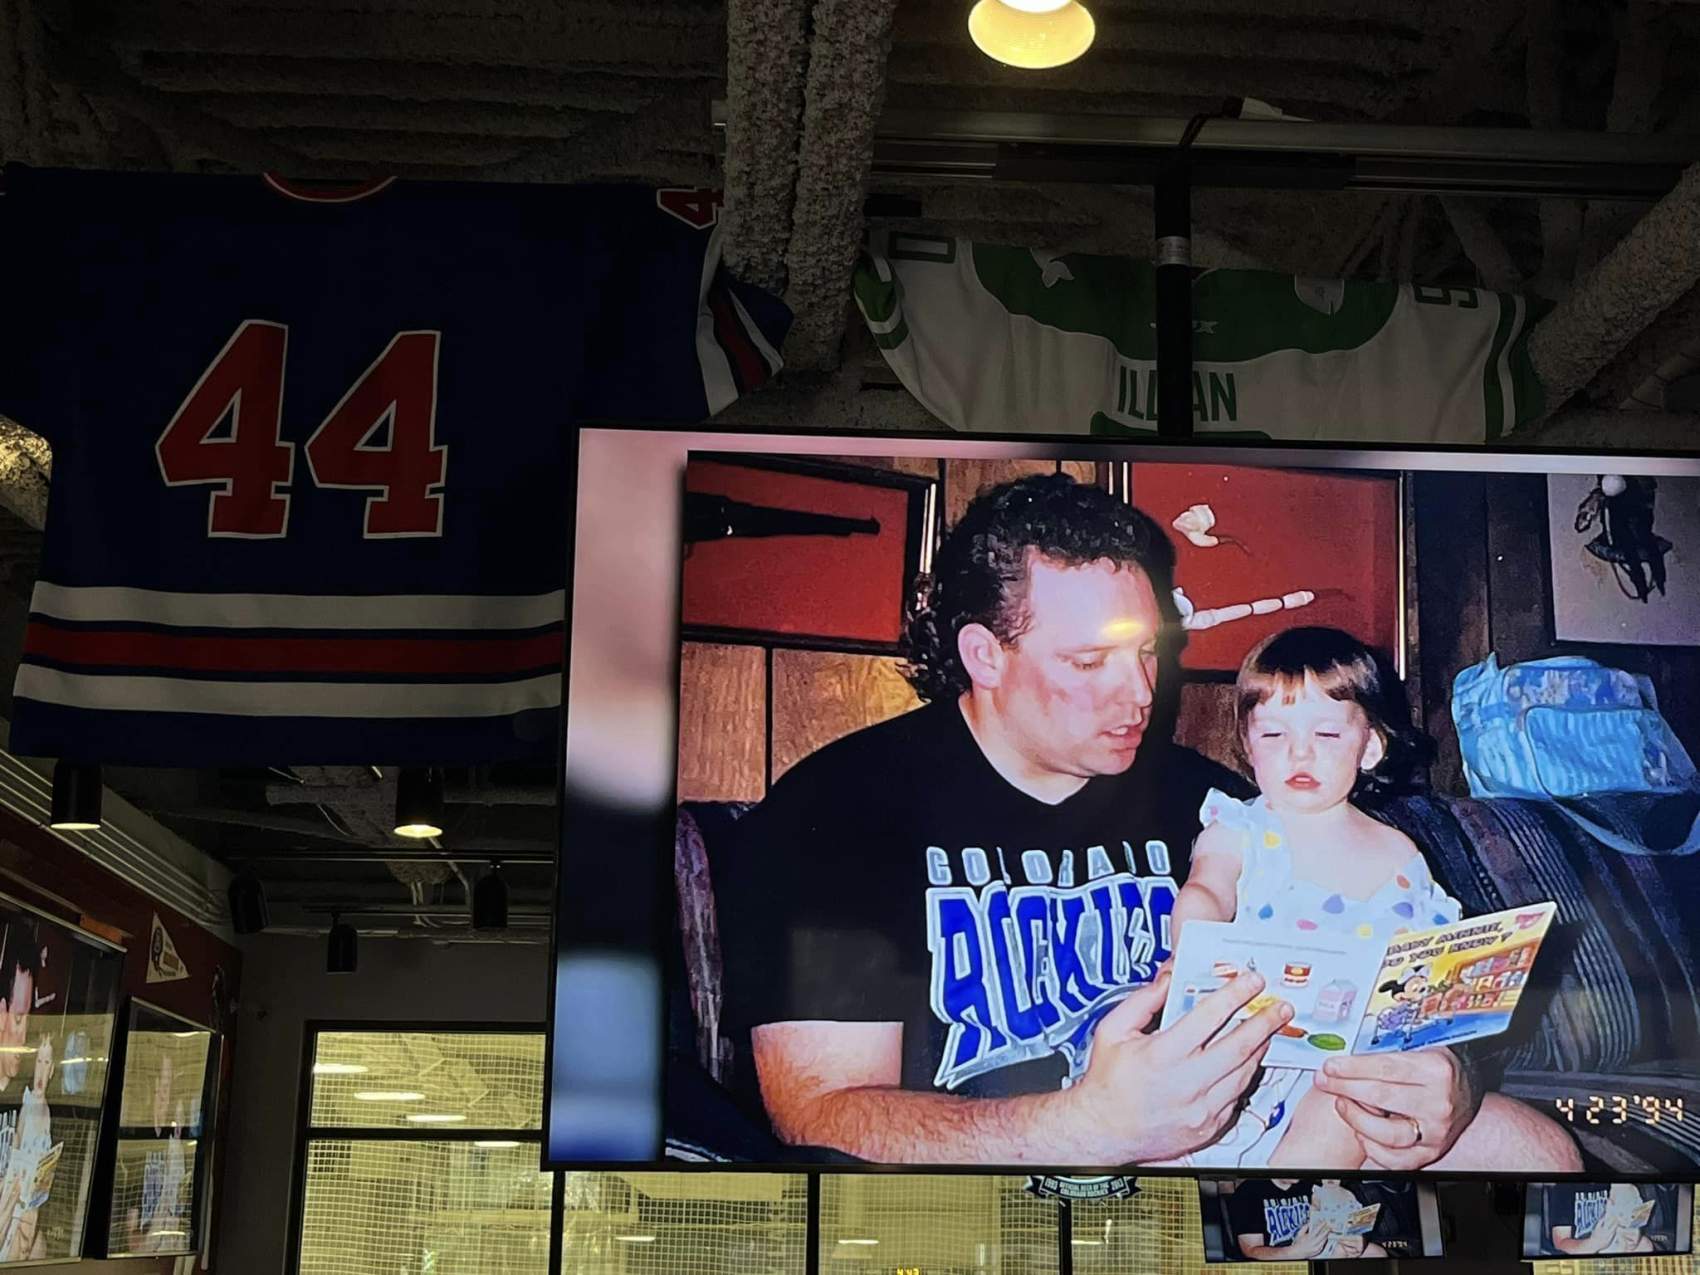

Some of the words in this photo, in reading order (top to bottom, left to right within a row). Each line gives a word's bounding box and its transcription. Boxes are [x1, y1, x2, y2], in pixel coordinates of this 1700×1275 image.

[1118, 366, 1237, 422] ILLAN
[155, 318, 448, 540] 44
[1556, 1098, 1574, 1122] 4
[1586, 1095, 1627, 1125] 23
